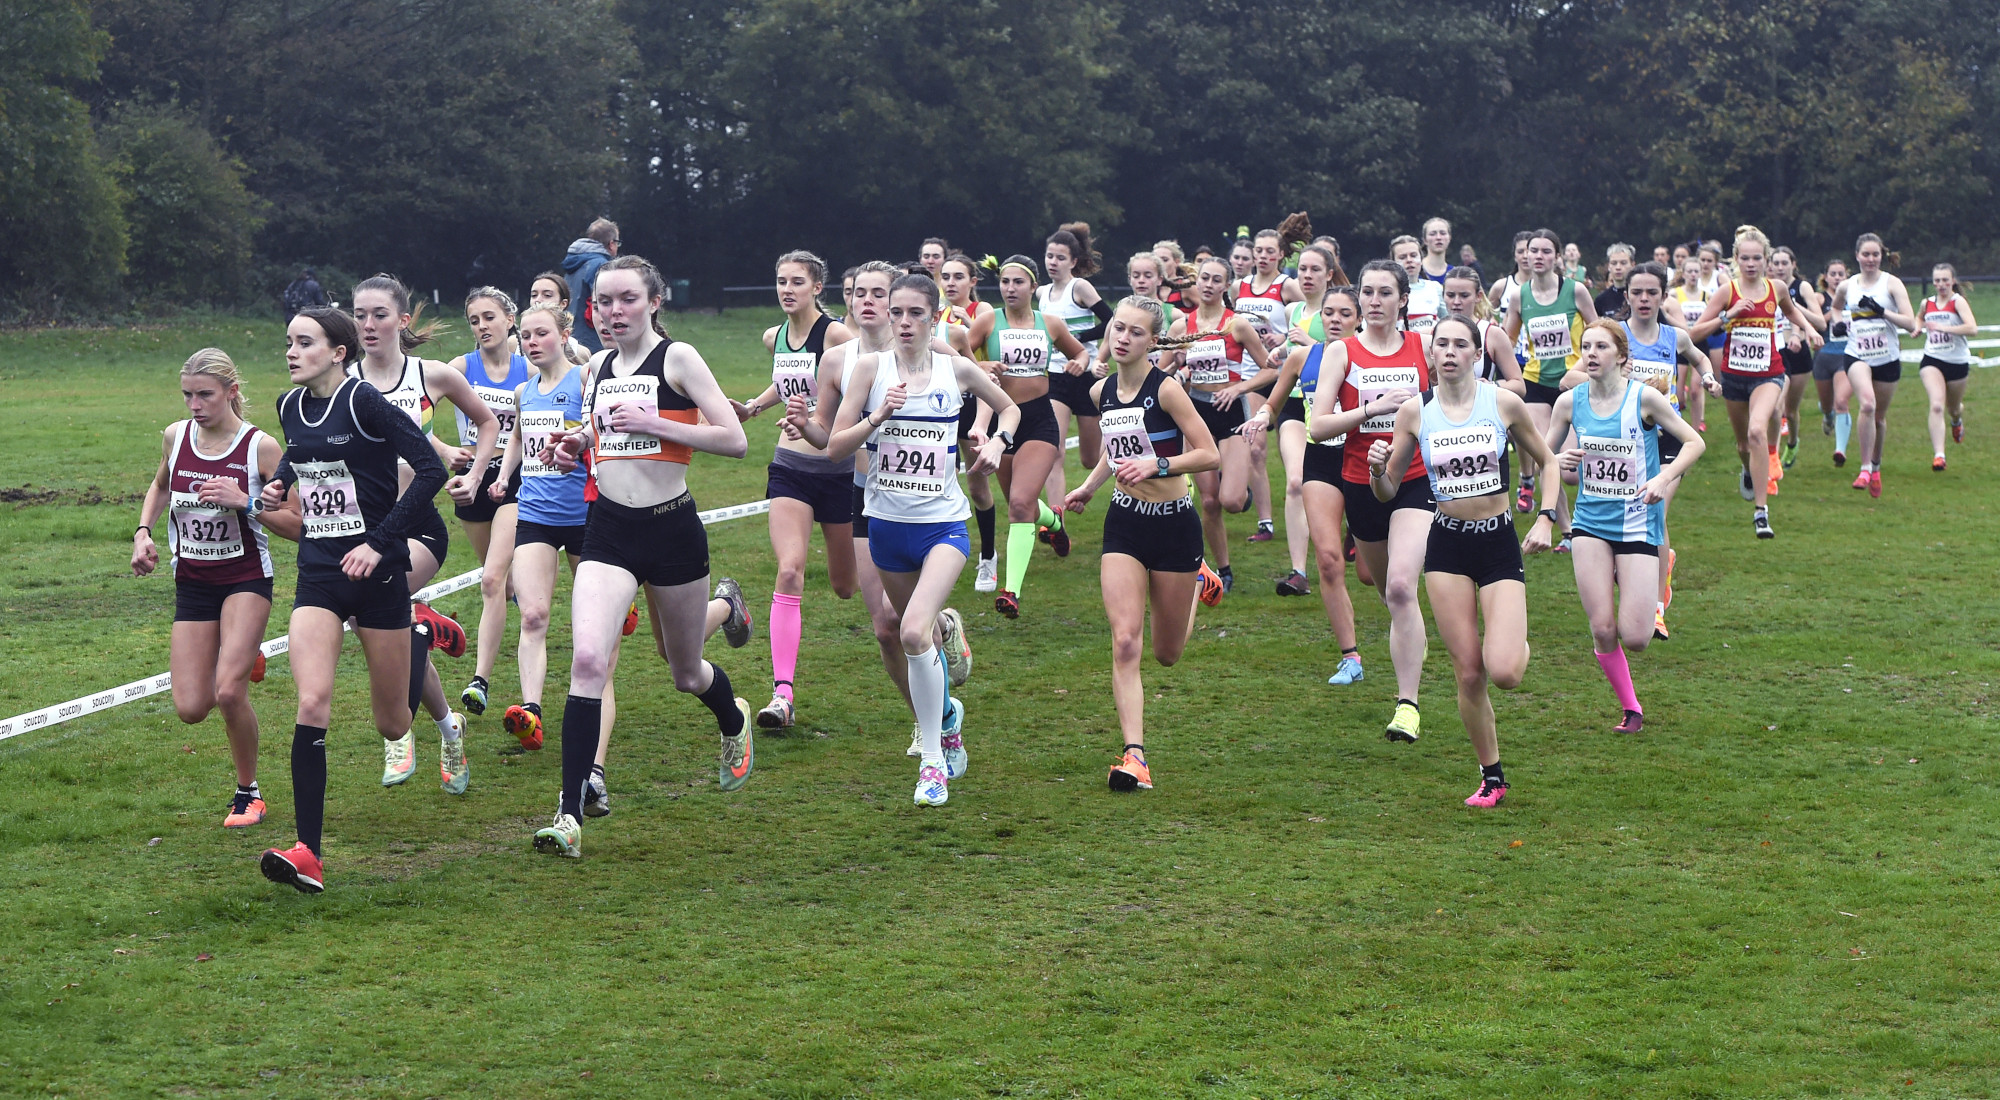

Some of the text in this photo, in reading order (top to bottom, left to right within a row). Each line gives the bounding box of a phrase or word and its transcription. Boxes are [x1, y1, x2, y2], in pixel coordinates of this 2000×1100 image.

[1531, 319, 1565, 329] saucony
[1003, 333, 1044, 341] saucony
[1541, 332, 1564, 347] 297
[1864, 337, 1884, 350] 316
[1003, 348, 1042, 364] A 299
[1535, 347, 1572, 357] MANSFIELD
[1740, 344, 1765, 359] 308
[776, 360, 813, 369] saucony
[1362, 373, 1416, 384] saucony
[600, 383, 652, 395] saucony
[783, 378, 811, 397] 304
[521, 417, 561, 427] saucony
[1101, 415, 1141, 427] saucony
[1361, 420, 1395, 429] MANSF
[883, 427, 946, 441] saucony
[1433, 433, 1493, 448] saucony
[528, 437, 545, 458] 34
[600, 440, 658, 451] MANSFIELD
[1111, 435, 1144, 459] 288
[1583, 442, 1634, 455] saucony
[523, 463, 560, 472] MANSFIEL
[880, 449, 936, 475] A 294
[1437, 454, 1489, 479] A 332
[177, 470, 214, 480] NEWQUAY
[297, 468, 345, 480] saucony
[1586, 460, 1629, 482] A 346
[879, 478, 942, 492] MANSFIELD
[1439, 478, 1499, 495] MANSFIELD
[1584, 484, 1635, 496] MANSFIELD
[175, 499, 230, 513] saucony
[303, 489, 346, 517] A 329
[653, 493, 691, 515] NIKE PRO
[1134, 500, 1174, 516] NIKE
[182, 519, 230, 542] A 322
[1461, 516, 1499, 534] PRO
[181, 544, 241, 556] MANSFIELD
[24, 713, 48, 729] saucony
[58, 703, 83, 719] saucony
[92, 693, 115, 708] saucony
[124, 684, 147, 699] saucony
[155, 677, 171, 689] sauco
